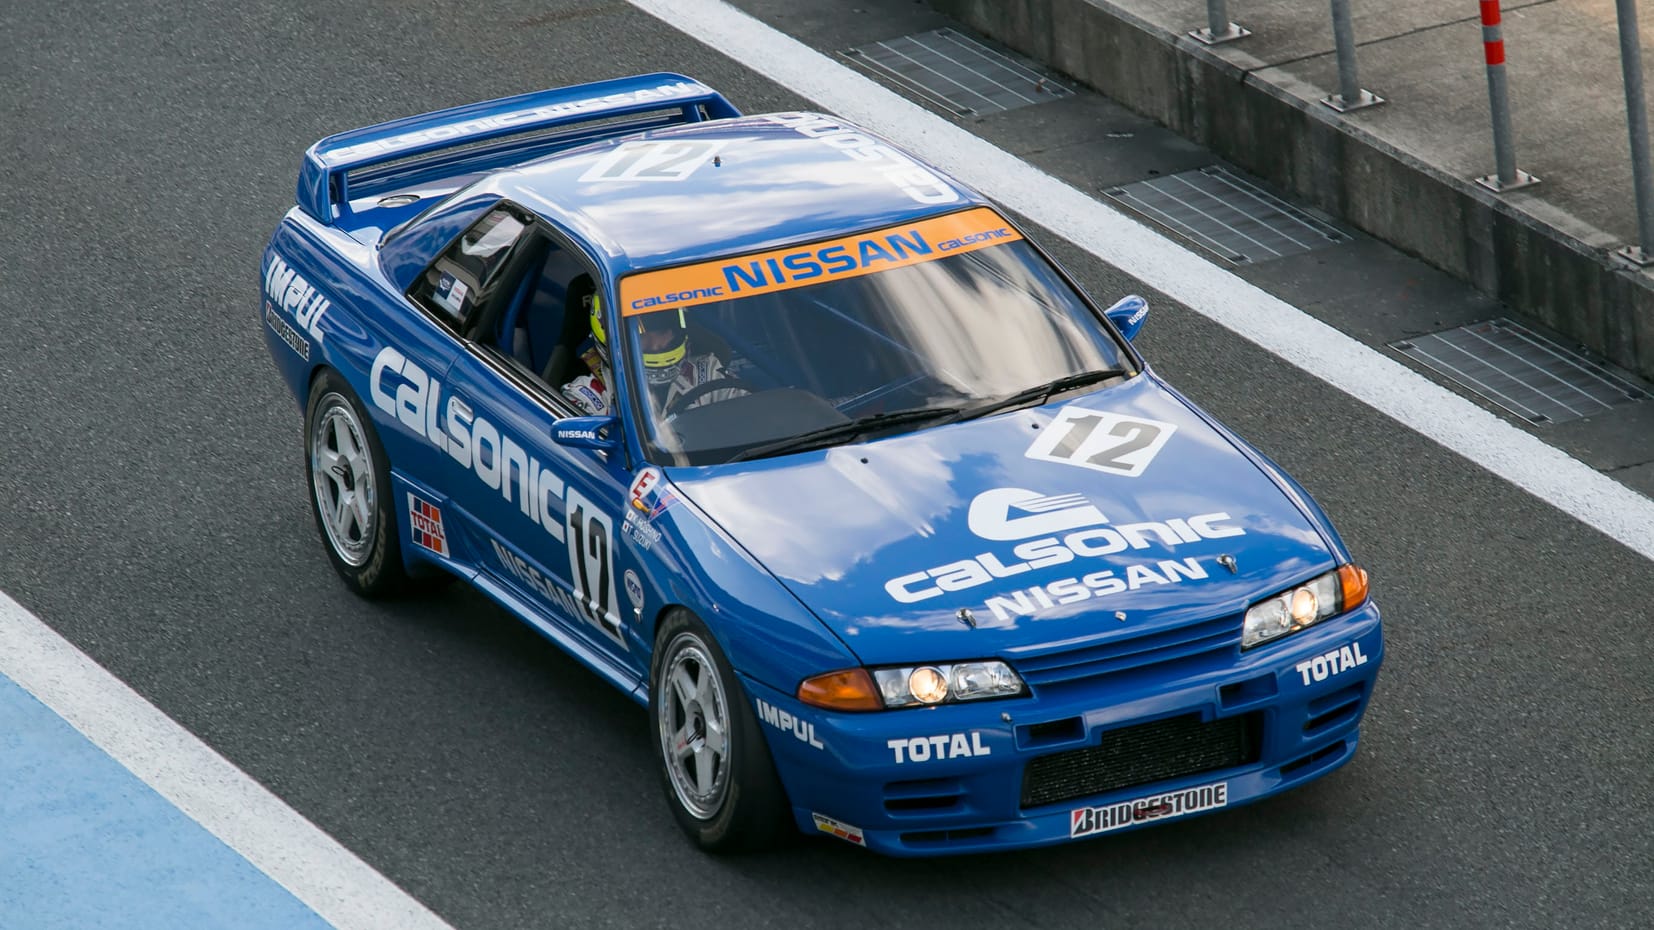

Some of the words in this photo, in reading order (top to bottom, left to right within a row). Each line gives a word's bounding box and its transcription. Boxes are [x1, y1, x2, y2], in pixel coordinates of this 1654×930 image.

[600, 143, 713, 178] 12
[722, 230, 933, 292] NISSAN
[265, 255, 331, 343] IMPUL
[266, 301, 309, 361] BRIDGESTONE
[558, 430, 596, 439] NISSAN
[1049, 414, 1162, 470] 12
[633, 472, 656, 497] E
[411, 511, 445, 540] TOTAL
[489, 538, 585, 625] NISSAN
[570, 503, 622, 640] 12
[983, 557, 1209, 620] NISSAN
[1297, 642, 1368, 686] TOTAL
[756, 698, 824, 750] IMPUL
[888, 732, 991, 764] TOTAL
[1074, 784, 1226, 835] BRIDGESTONE
